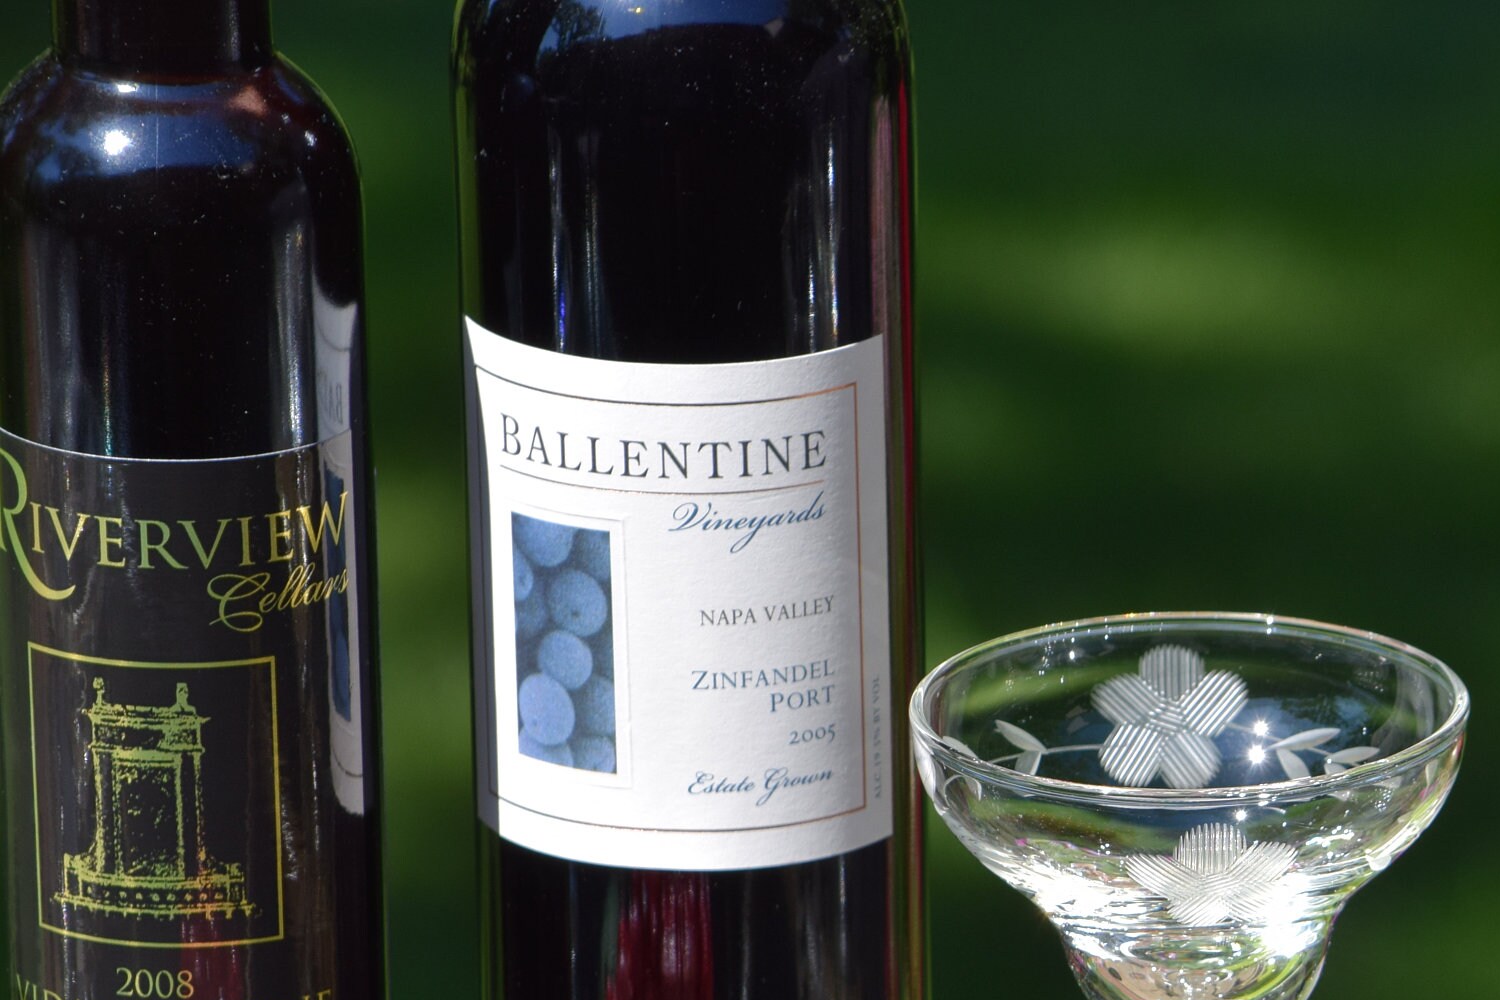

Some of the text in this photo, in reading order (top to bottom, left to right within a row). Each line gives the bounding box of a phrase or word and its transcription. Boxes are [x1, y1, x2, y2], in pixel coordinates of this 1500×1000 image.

[499, 411, 827, 479] BALLENTINE
[0, 447, 348, 600] RIVERVIEW
[668, 491, 826, 554] Vineyards
[207, 563, 349, 632] Cellars
[700, 595, 835, 627] NAPA VALLEY
[691, 659, 834, 690] ZINFANDEL
[770, 685, 836, 713] PORT
[788, 723, 836, 745] 2005
[687, 767, 833, 806] Estate Grown
[116, 967, 194, 999] 2008
